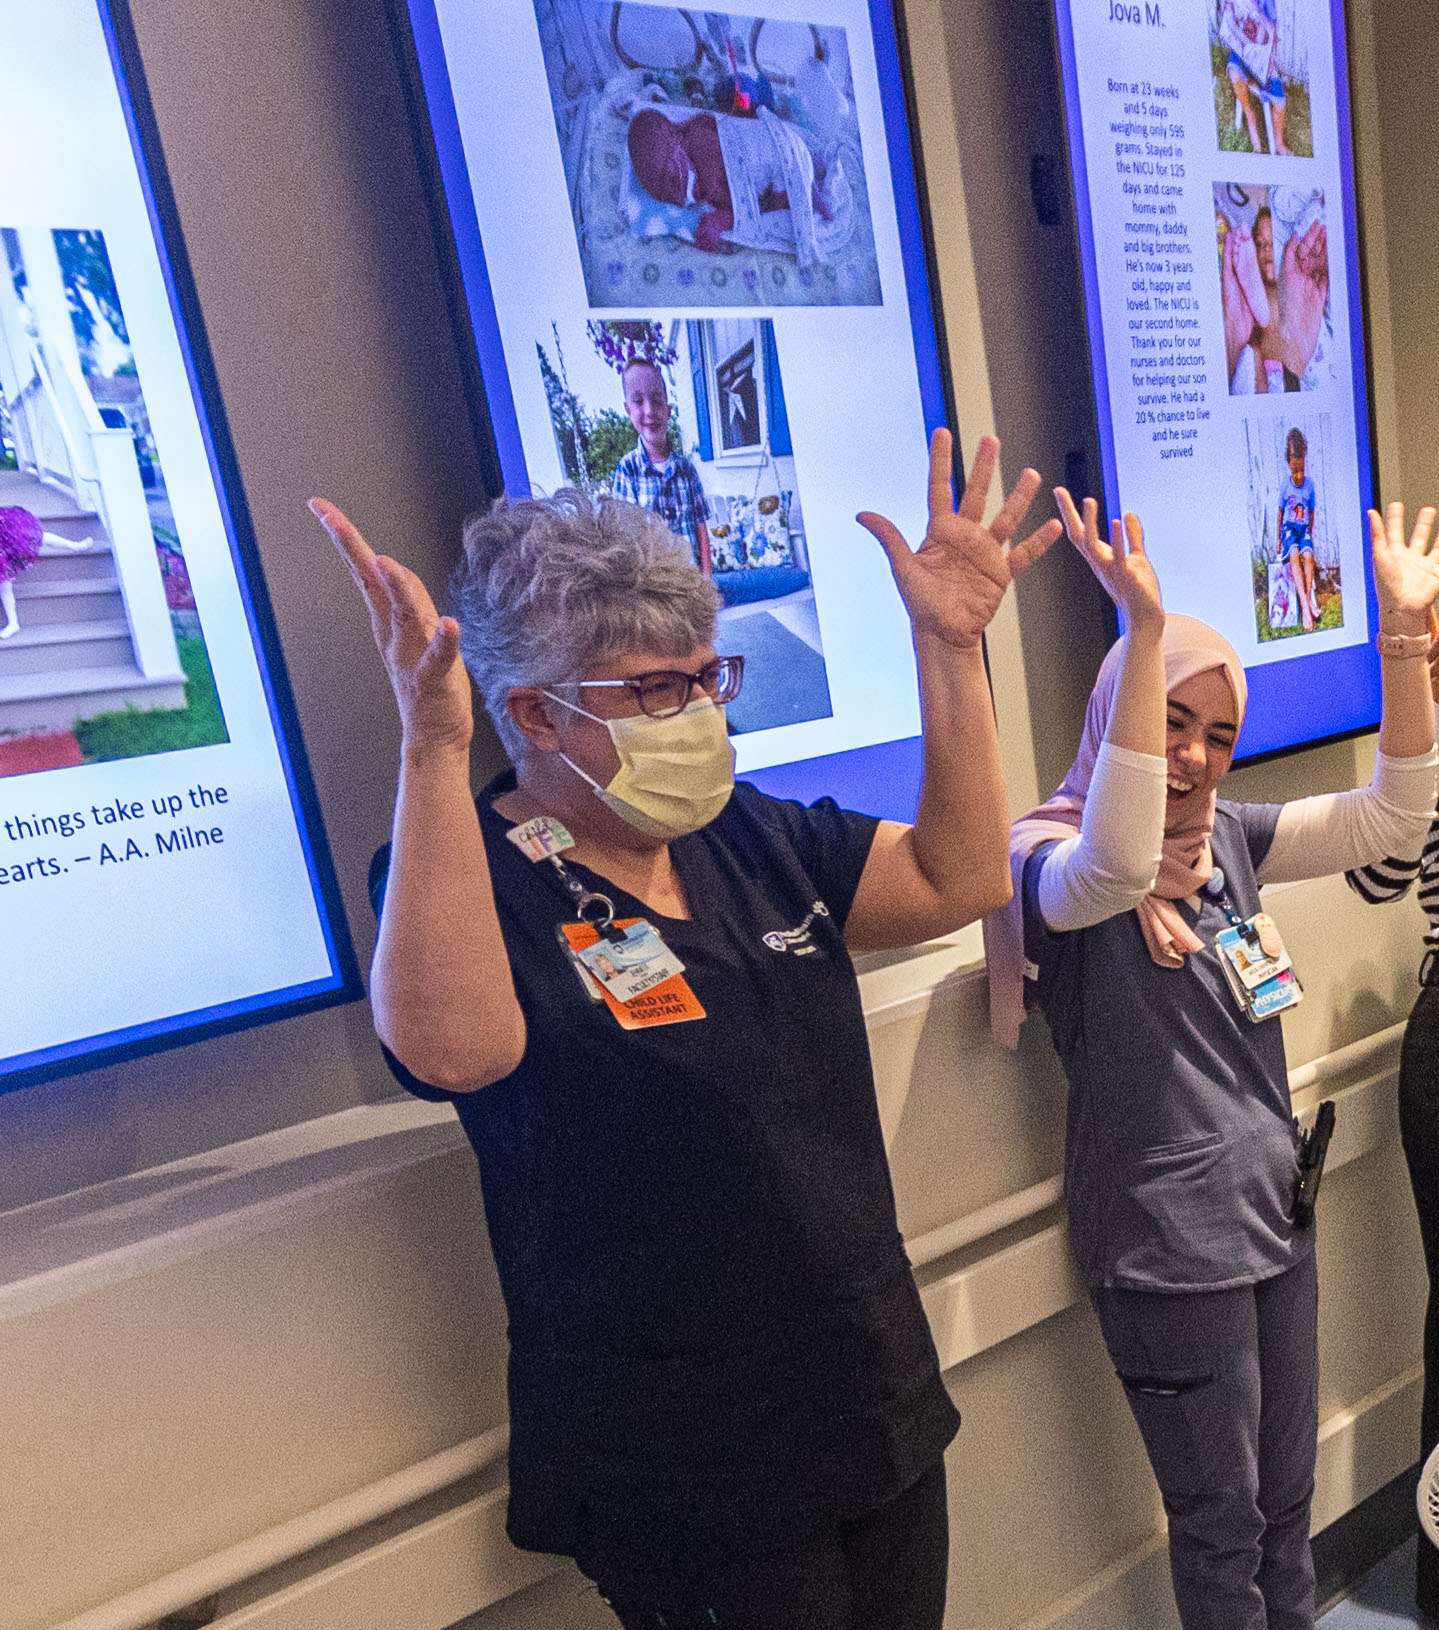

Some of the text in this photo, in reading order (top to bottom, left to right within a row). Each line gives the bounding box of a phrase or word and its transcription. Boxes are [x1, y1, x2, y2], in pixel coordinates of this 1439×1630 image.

[1109, 0, 1167, 28] Jova M.
[1107, 78, 1180, 98] Born at 23 weeks
[1123, 101, 1168, 118] and 5 days
[1109, 121, 1148, 138] weighing
[1150, 122, 1168, 140] only
[1115, 142, 1182, 158] grams. Stayed in
[1116, 160, 1185, 177] the NICU for 125
[1122, 180, 1183, 196] days and came
[1132, 200, 1176, 214] home with
[1124, 221, 1188, 236] mommy, daddy
[1124, 240, 1139, 252] and
[1141, 240, 1154, 256] big
[1126, 259, 1194, 275] He's now 3 years
[1132, 278, 1191, 294] old, happy and
[1126, 297, 1200, 310] loved. The NICU is
[1128, 316, 1200, 330] our second home.
[1130, 334, 1201, 350] Thank you for our
[1130, 354, 1206, 368] nurses and doctors
[1132, 372, 1206, 388] for helping our son
[1170, 391, 1182, 404] He
[1183, 390, 1198, 402] had
[1200, 392, 1205, 402] a
[1136, 410, 1146, 424] 20
[1156, 410, 1185, 422] chance
[1186, 410, 1195, 420] to
[1197, 408, 1210, 420] live
[1152, 427, 1198, 442] and he sure
[1160, 444, 1194, 460] survived
[4, 784, 229, 841] things take up the
[100, 838, 149, 866] A.A.
[155, 826, 225, 854] Milne
[624, 992, 681, 1010] CHILD LIFE
[630, 1003, 688, 1021] ASSISTANT
